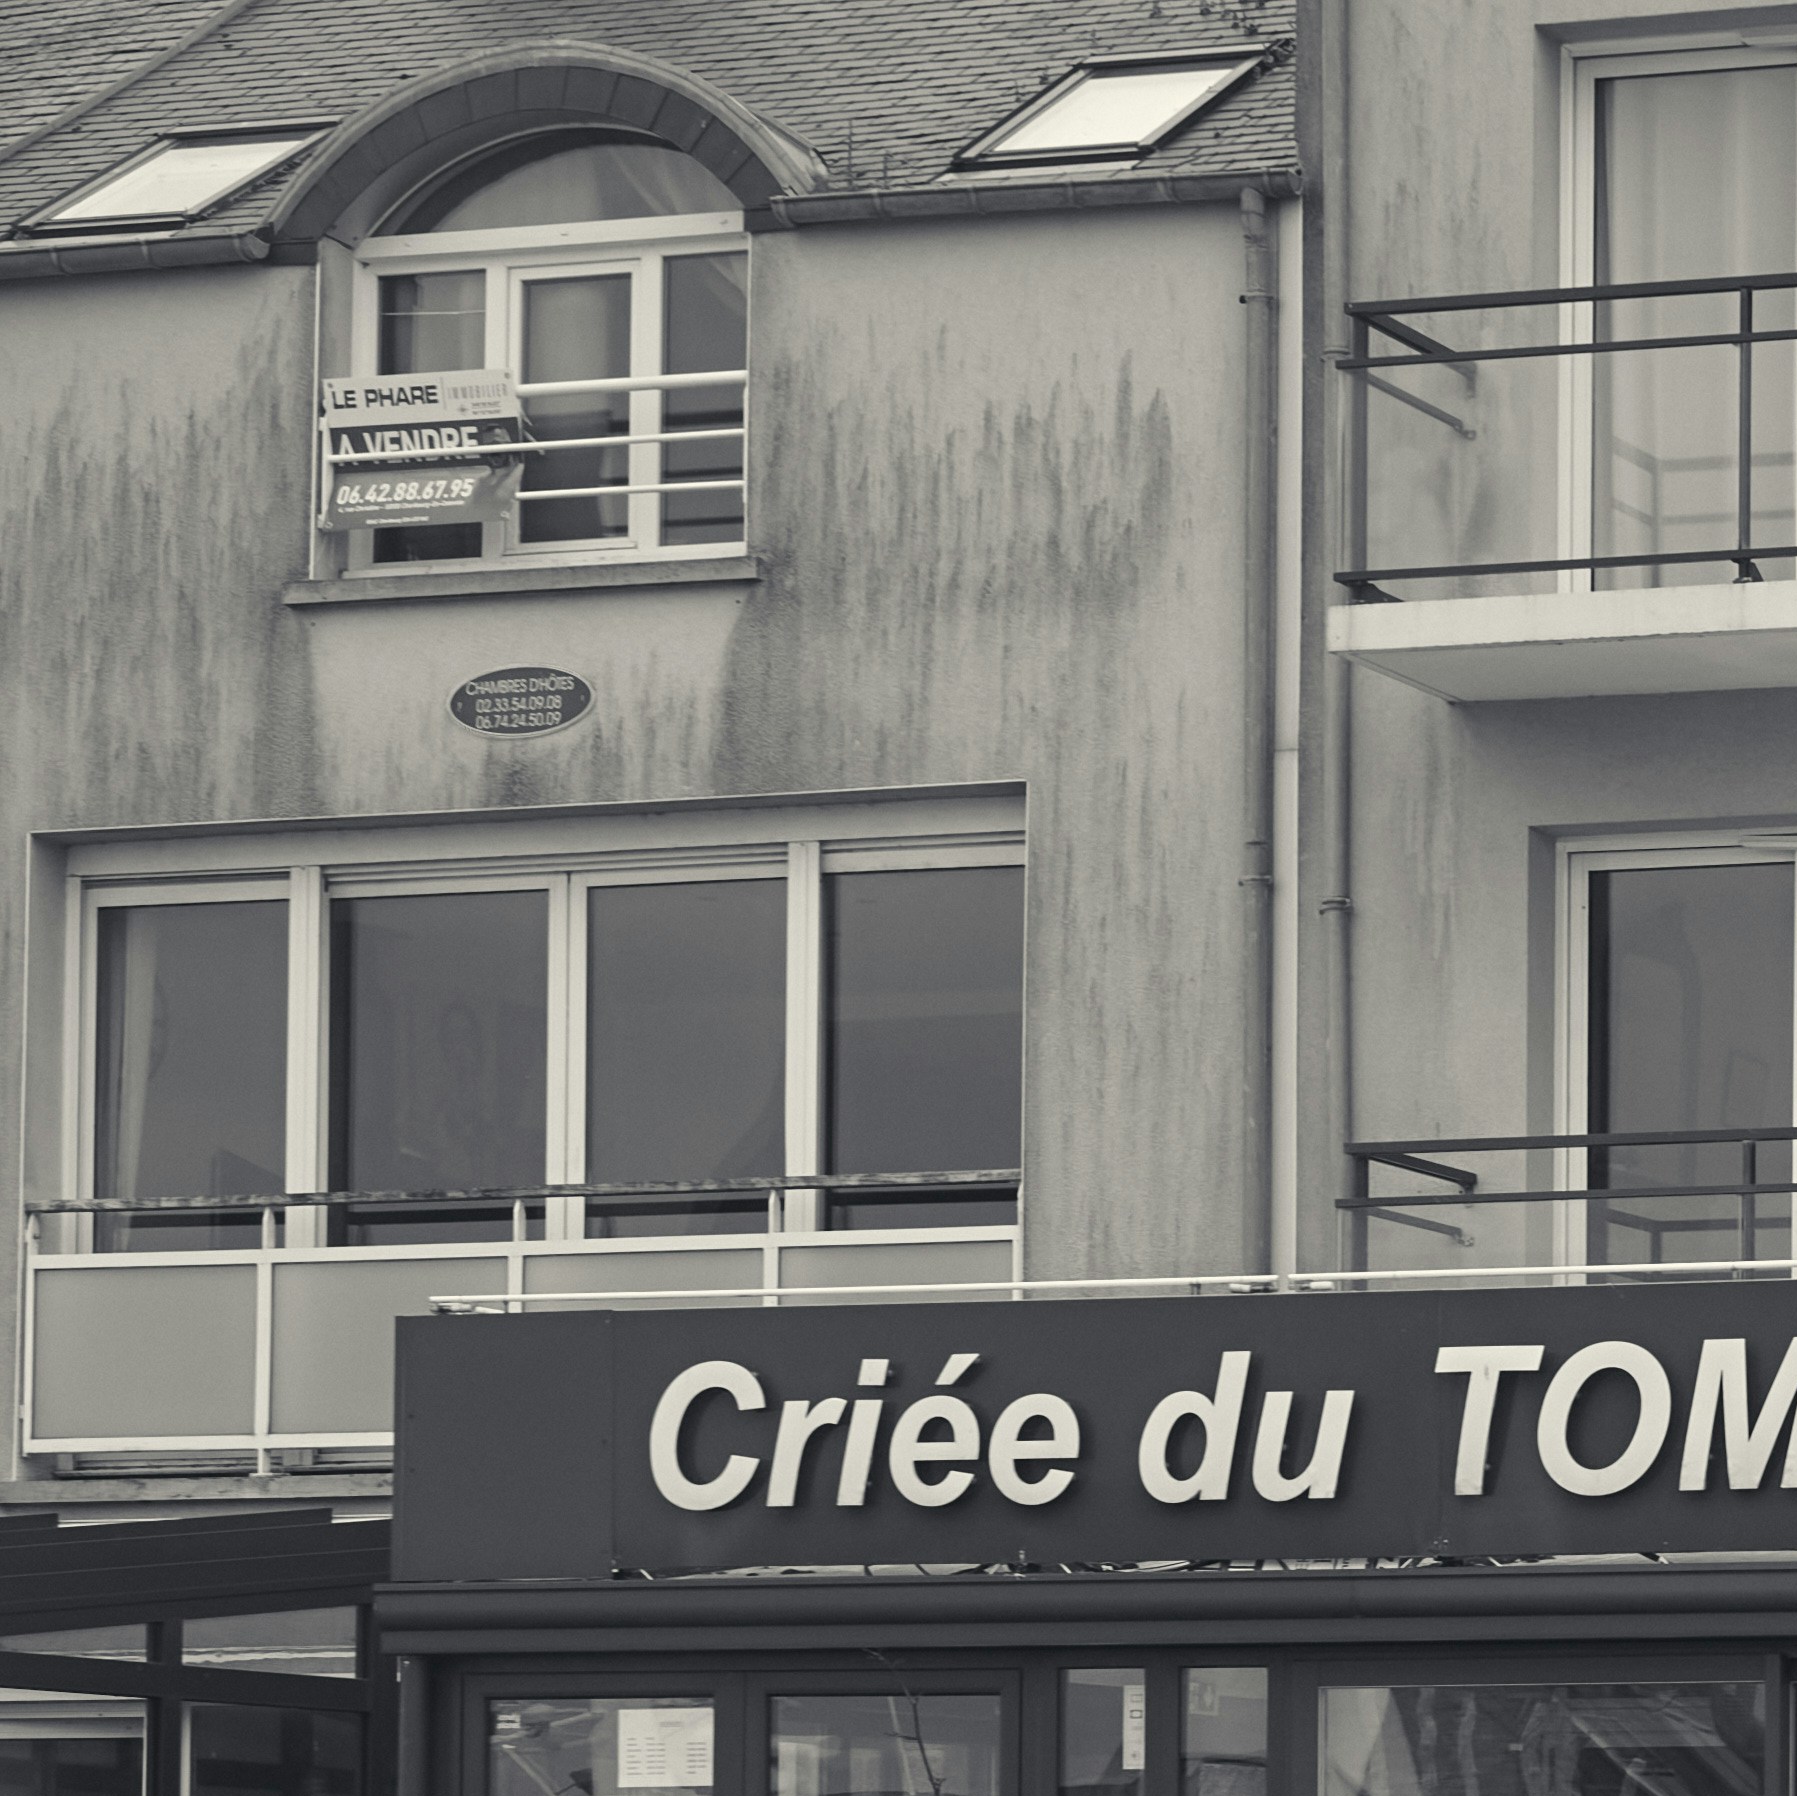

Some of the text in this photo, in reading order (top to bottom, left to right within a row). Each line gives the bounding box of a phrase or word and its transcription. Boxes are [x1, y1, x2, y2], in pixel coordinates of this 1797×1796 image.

[332, 383, 508, 409] LE PHARE IMMOBILIER
[363, 426, 481, 465] VENDRE
[336, 478, 476, 504] 06.42.88.67.95
[465, 678, 527, 695] CHAMBRES
[650, 1354, 1080, 1510] Criée
[1139, 1350, 1355, 1504] du
